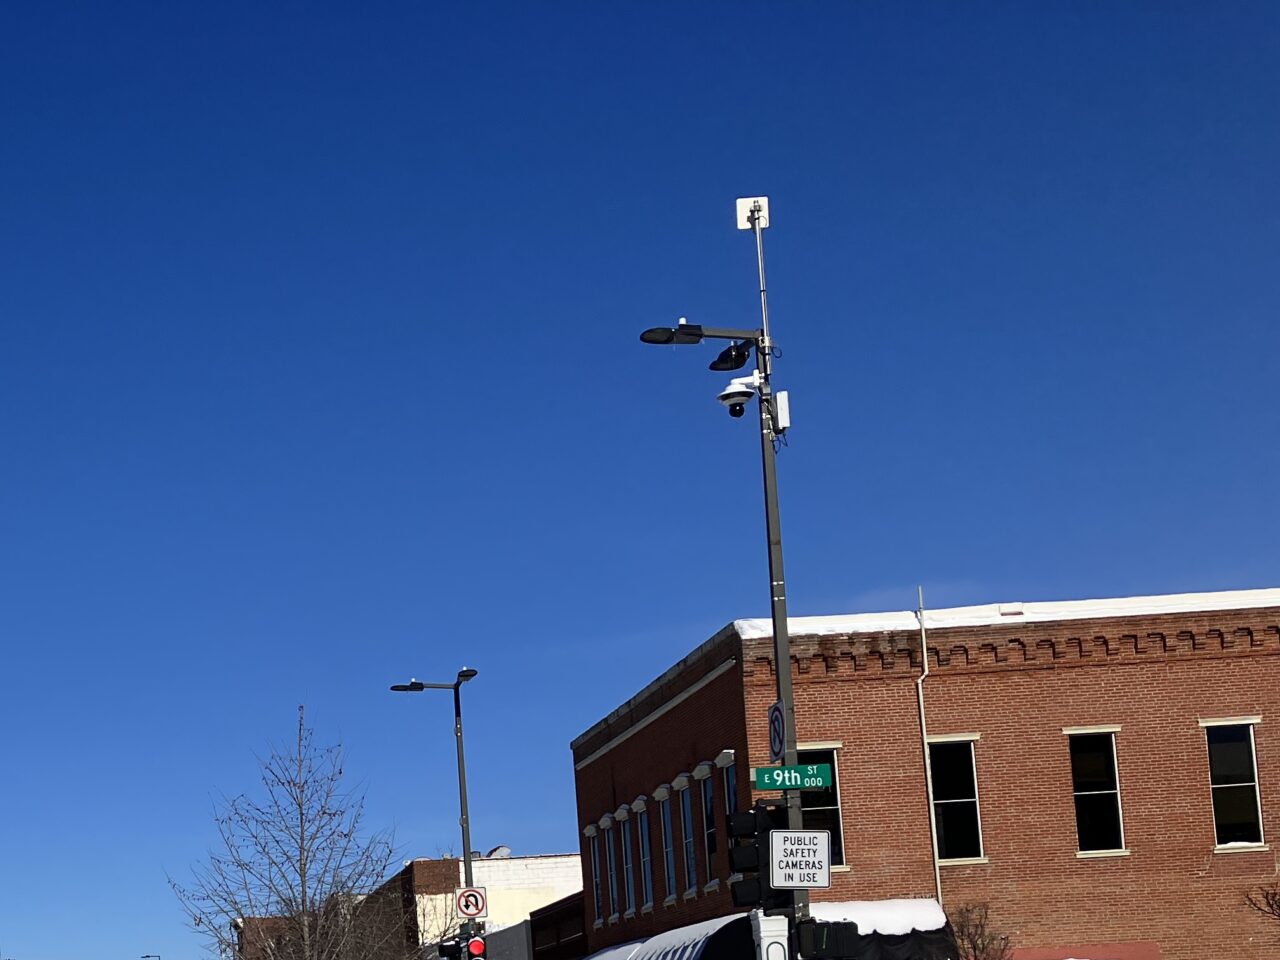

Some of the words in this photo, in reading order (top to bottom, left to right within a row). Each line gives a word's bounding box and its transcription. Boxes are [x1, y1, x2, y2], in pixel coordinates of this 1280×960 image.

[764, 774, 771, 783] E
[773, 769, 801, 786] 9th
[807, 765, 818, 775] ST
[804, 777, 823, 787] 000
[783, 836, 818, 846] PUBLIC
[783, 848, 818, 858] SAFETY
[778, 860, 823, 870] CAMERAS
[784, 872, 794, 882] IN
[799, 872, 818, 882] USE
